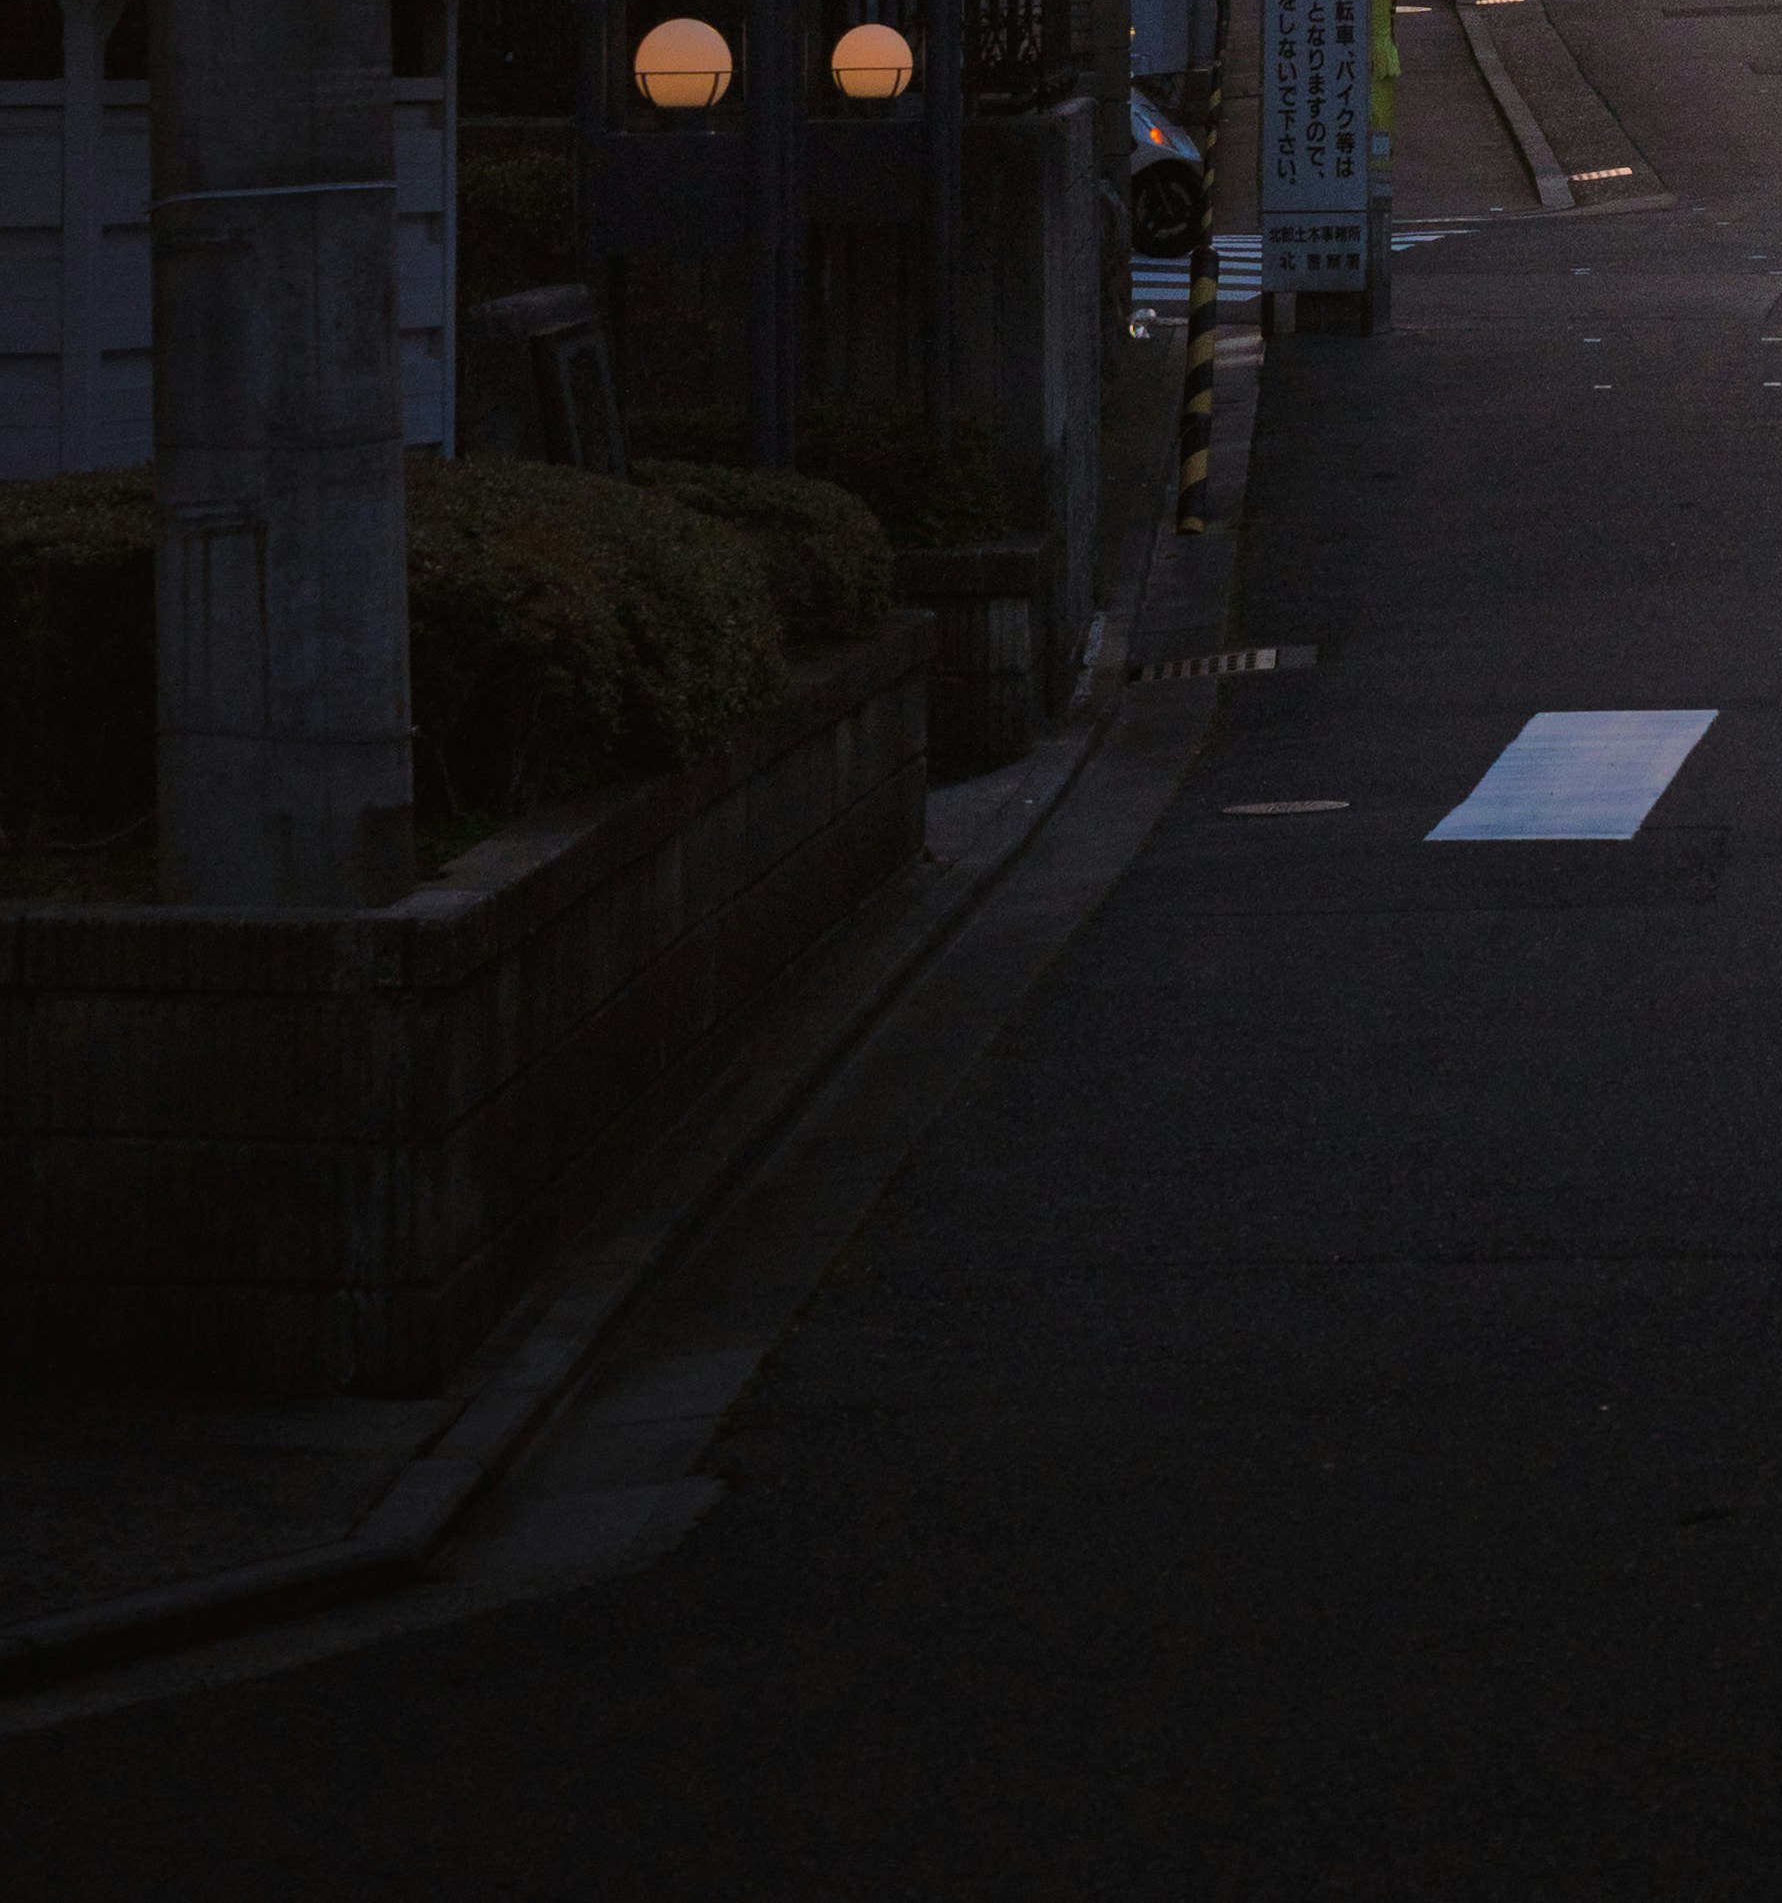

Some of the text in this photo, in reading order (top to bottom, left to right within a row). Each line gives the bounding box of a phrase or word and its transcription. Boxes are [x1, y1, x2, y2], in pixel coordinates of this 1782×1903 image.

[1268, 225, 1361, 243] 北部土木事務所
